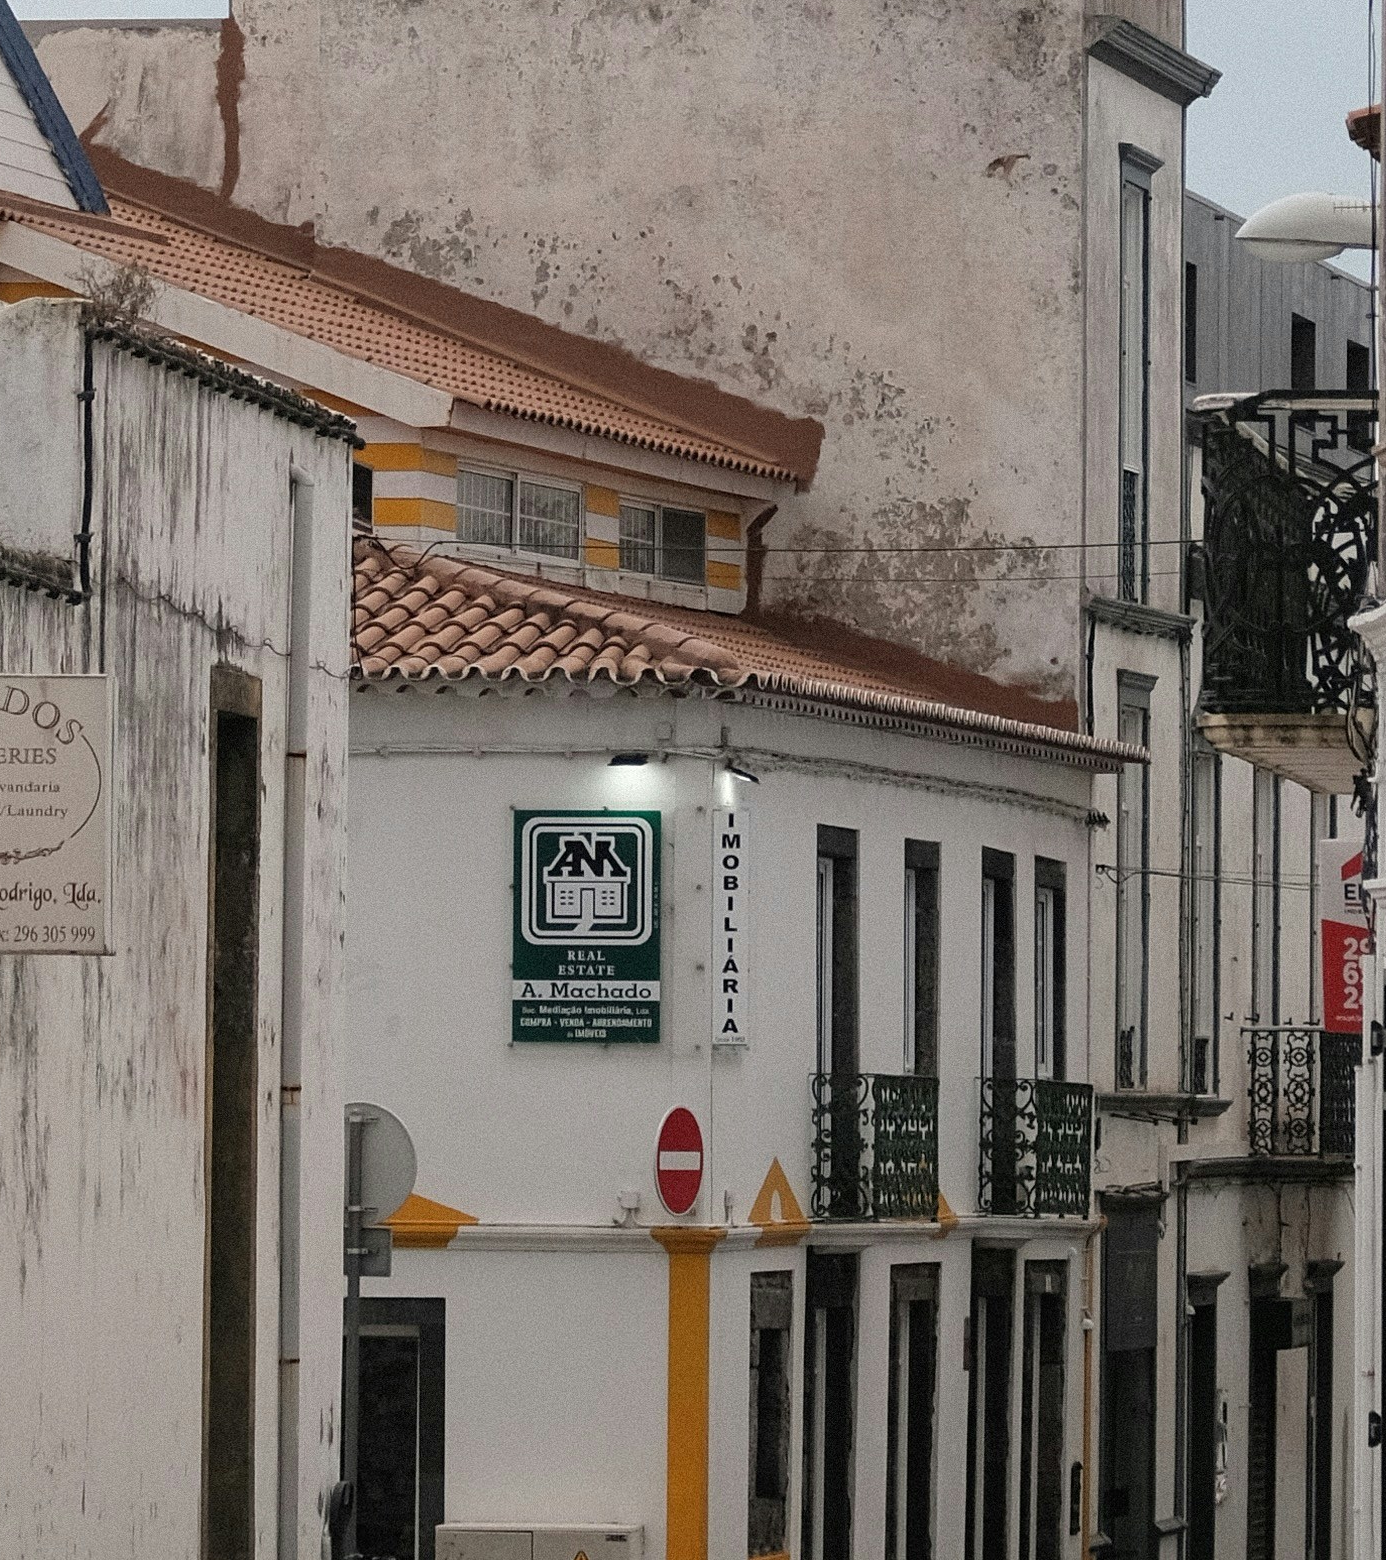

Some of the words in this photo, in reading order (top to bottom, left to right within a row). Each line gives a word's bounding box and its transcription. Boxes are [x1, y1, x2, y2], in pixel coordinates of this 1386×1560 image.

[722, 812, 741, 1034] IMOBILIÁRIA
[13, 924, 39, 943] 296
[42, 925, 67, 943] 305
[71, 925, 96, 943] 999
[567, 950, 606, 961] REAL
[557, 965, 616, 976] ESTATE
[520, 982, 543, 998] A.
[549, 982, 652, 999] Machado
[520, 1018, 552, 1027] COMPRA
[559, 1018, 585, 1027] VENDA
[591, 1018, 652, 1028] ARRENDAMENTO
